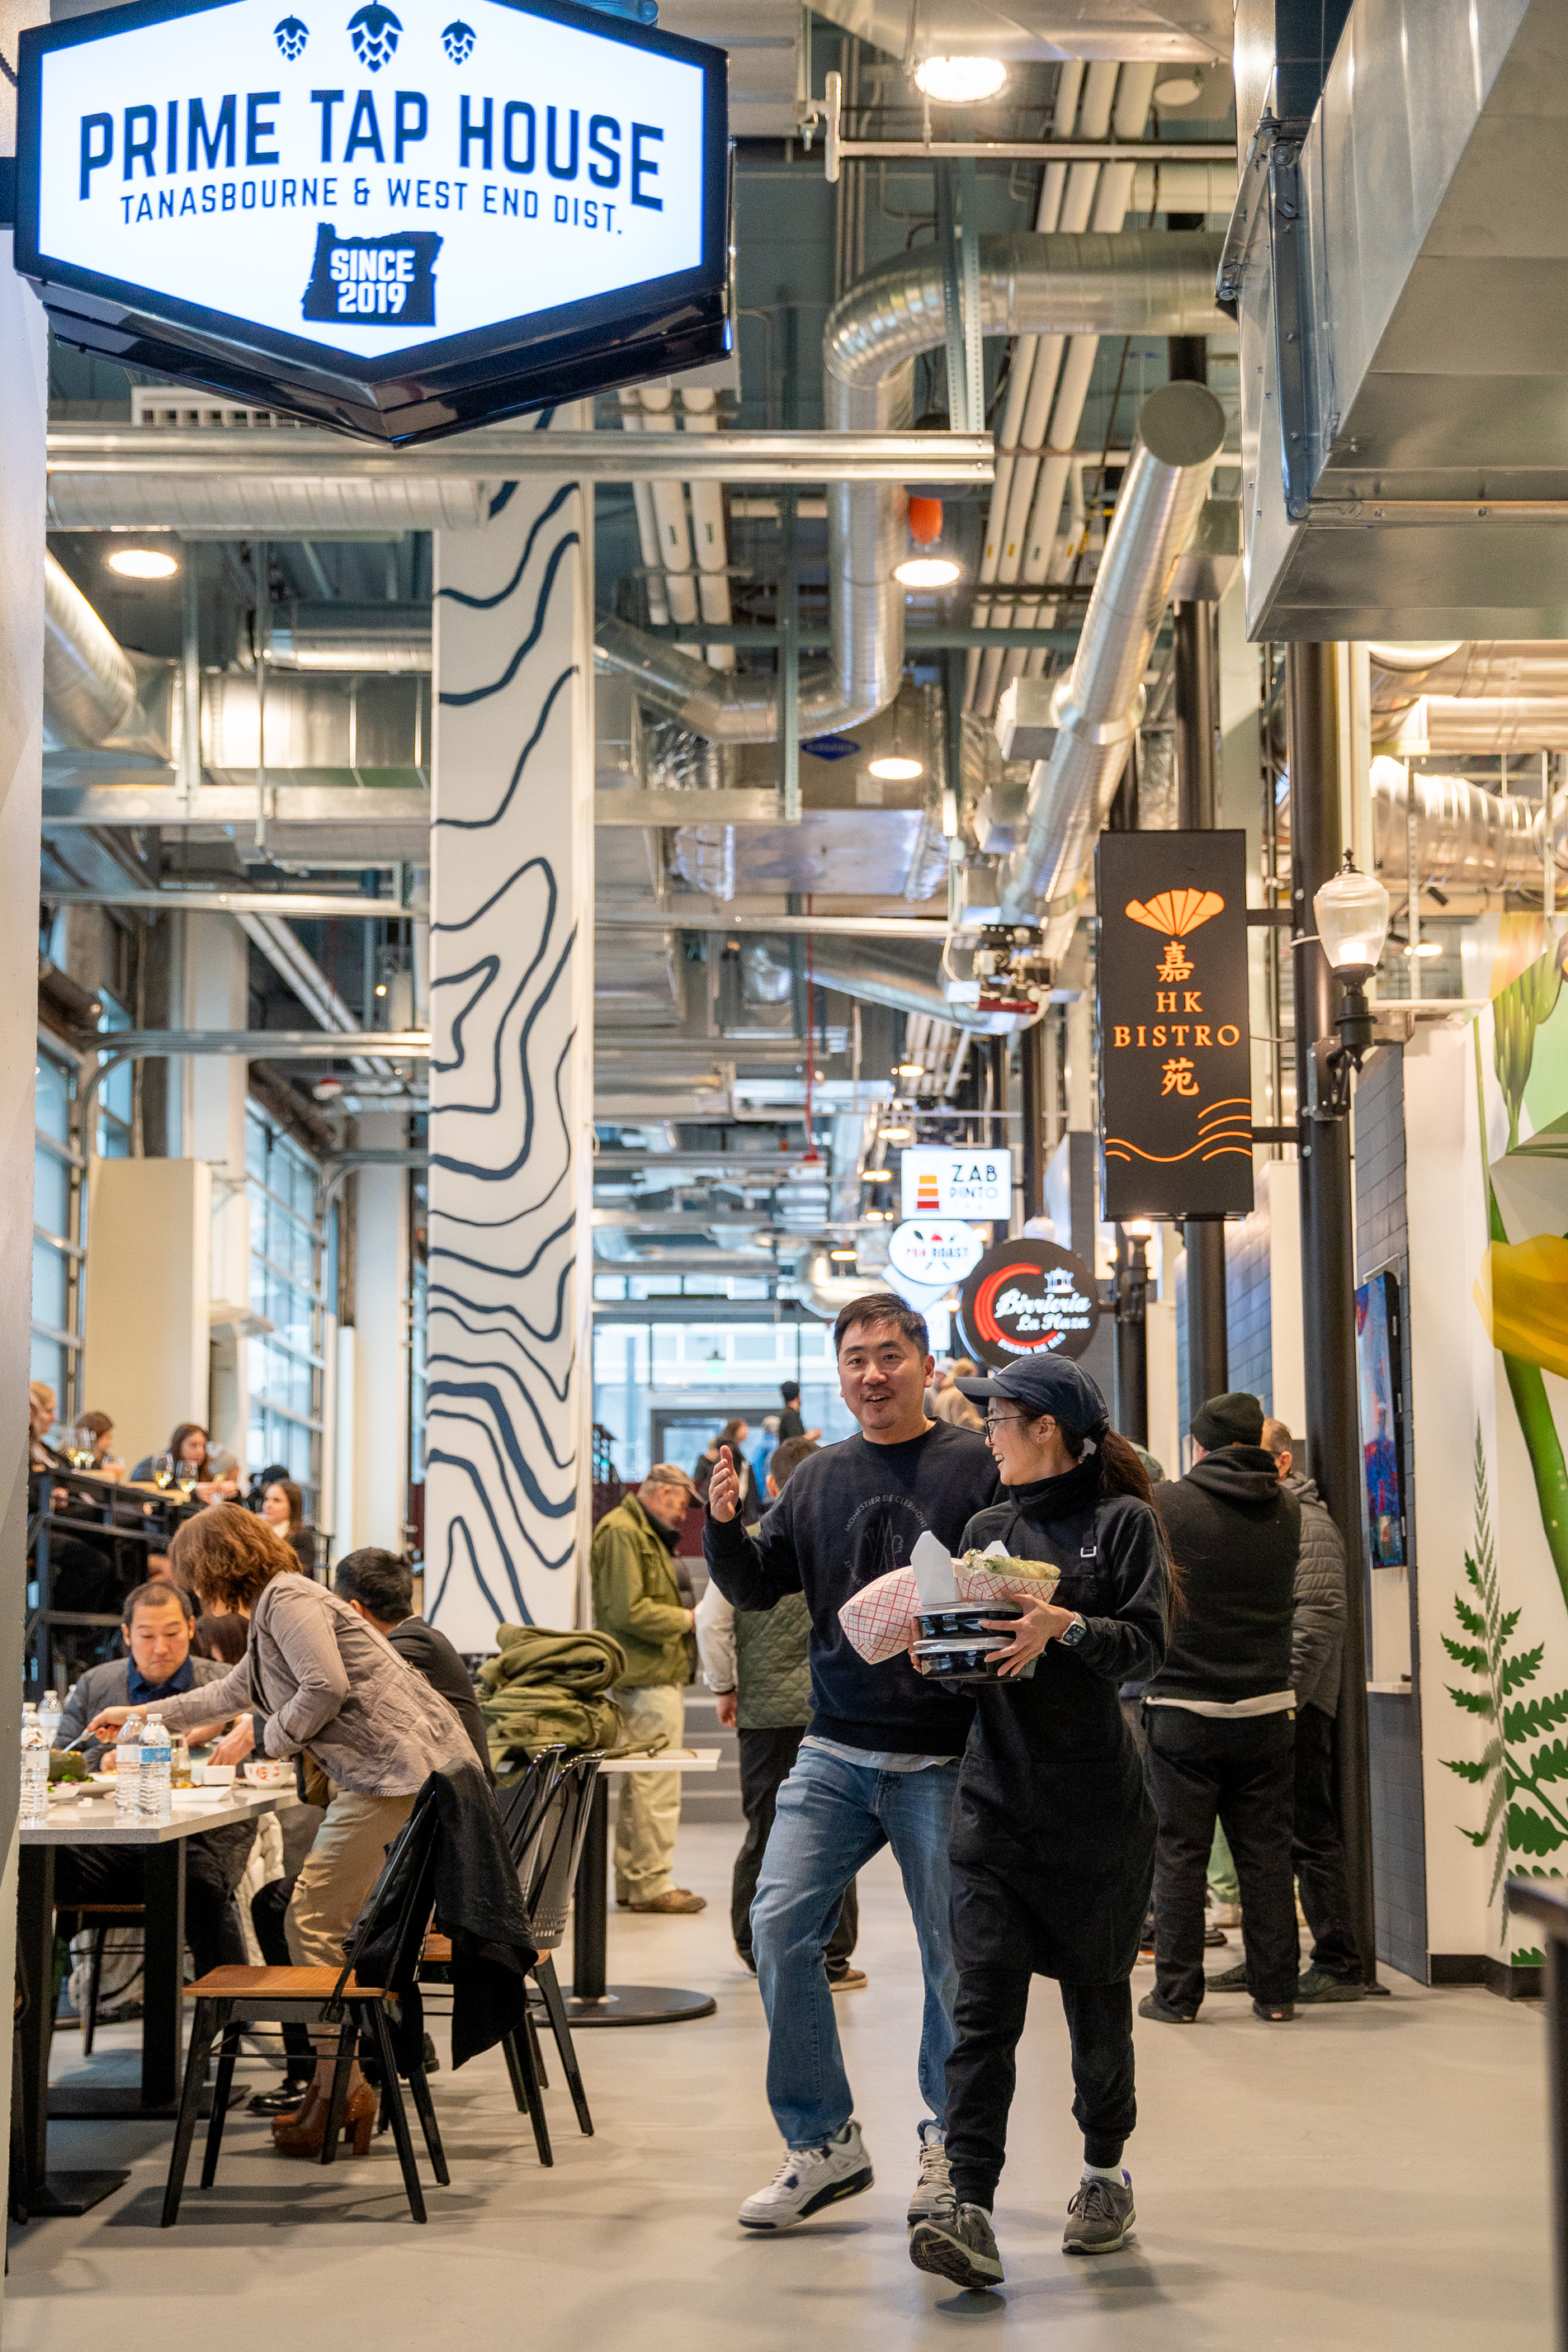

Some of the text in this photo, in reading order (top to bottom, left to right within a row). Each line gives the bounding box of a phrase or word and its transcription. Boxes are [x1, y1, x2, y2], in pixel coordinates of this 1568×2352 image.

[79, 90, 664, 212] PRIME TAP HOUSE
[120, 177, 622, 235] TANASBOURNE & WEST END DIST.
[330, 248, 416, 283] SINCE
[337, 281, 406, 314] 2019
[1155, 940, 1195, 984] 嘉
[1155, 991, 1203, 1013] HK
[1112, 1024, 1240, 1048] BISTRO
[1161, 1056, 1200, 1097] 苑
[951, 1164, 999, 1183] ZAB
[949, 1186, 999, 1200] PINTO
[994, 1287, 1092, 1319] Birrieria
[1016, 1312, 1091, 1331] La Plaza
[844, 1496, 881, 1532] MONESTIER
[895, 1496, 928, 1528] CLERMONT
